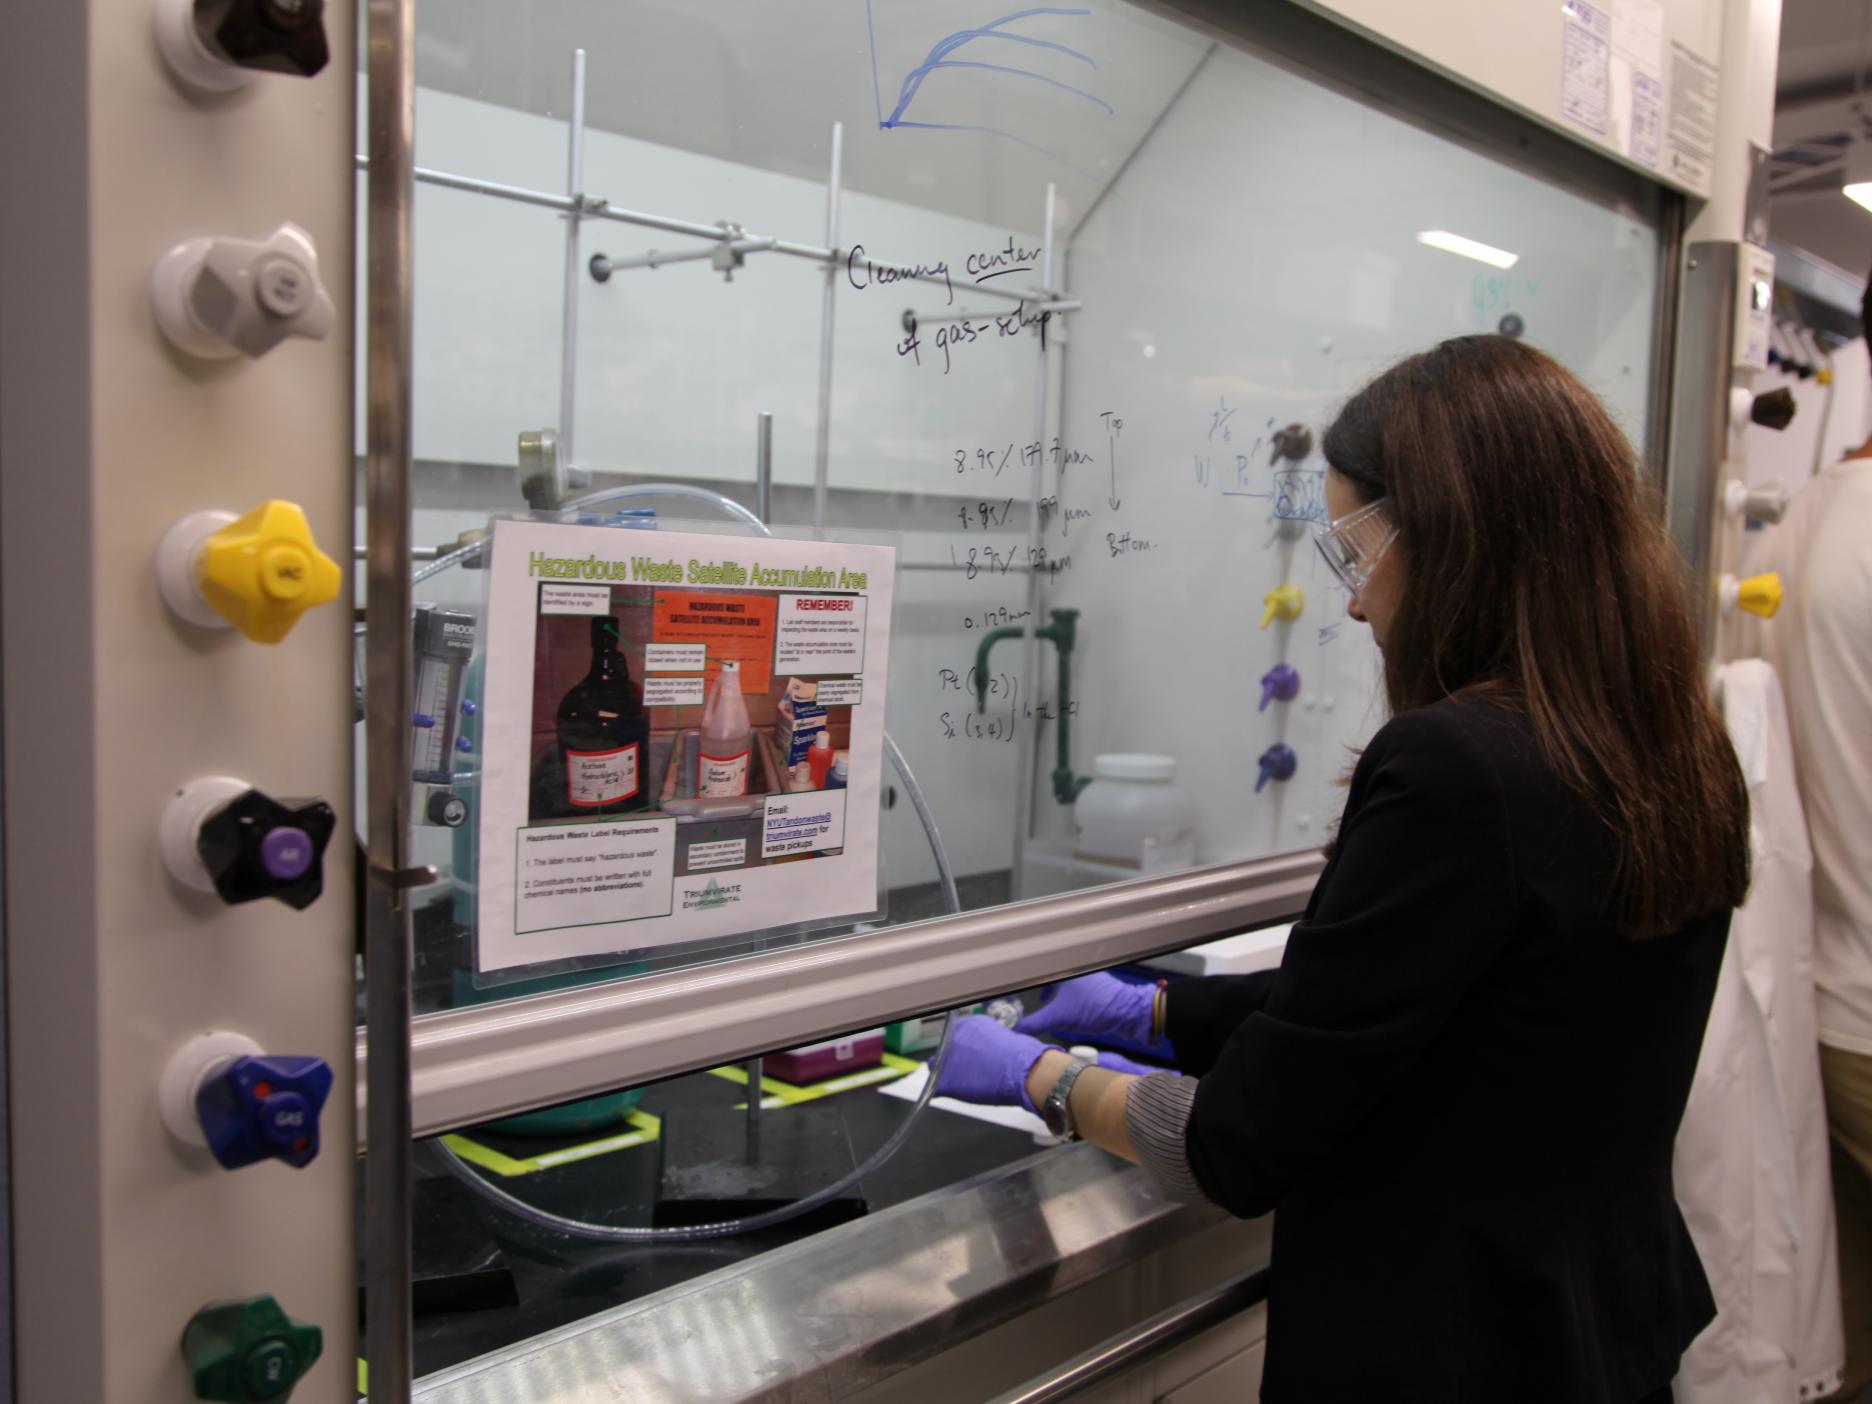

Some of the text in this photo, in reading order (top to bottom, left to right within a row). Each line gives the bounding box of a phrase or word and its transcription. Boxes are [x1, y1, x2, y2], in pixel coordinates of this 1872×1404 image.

[966, 236, 1042, 275] center
[1100, 411, 1124, 438] Top
[276, 565, 304, 581] VAC
[528, 552, 868, 590] Hazardous Waste Satellite Accumulation Area
[796, 599, 854, 611] REMEMBER!
[767, 805, 789, 816] Email:
[526, 826, 659, 843] Hazardous Waste Label Requirements
[819, 825, 829, 833] for
[765, 839, 813, 852] waste pickups
[533, 858, 547, 866] The
[548, 856, 565, 865] label
[566, 855, 583, 863] must
[585, 855, 596, 864] say
[532, 877, 575, 888] Constituents
[576, 875, 593, 883] must
[594, 873, 603, 882] be
[605, 872, 627, 881] written
[628, 870, 640, 879] with
[642, 869, 651, 877] full
[524, 889, 553, 899] chemical
[555, 887, 577, 896] names
[683, 884, 742, 899] TRIUMVIRATE
[275, 1110, 305, 1127] GAS
